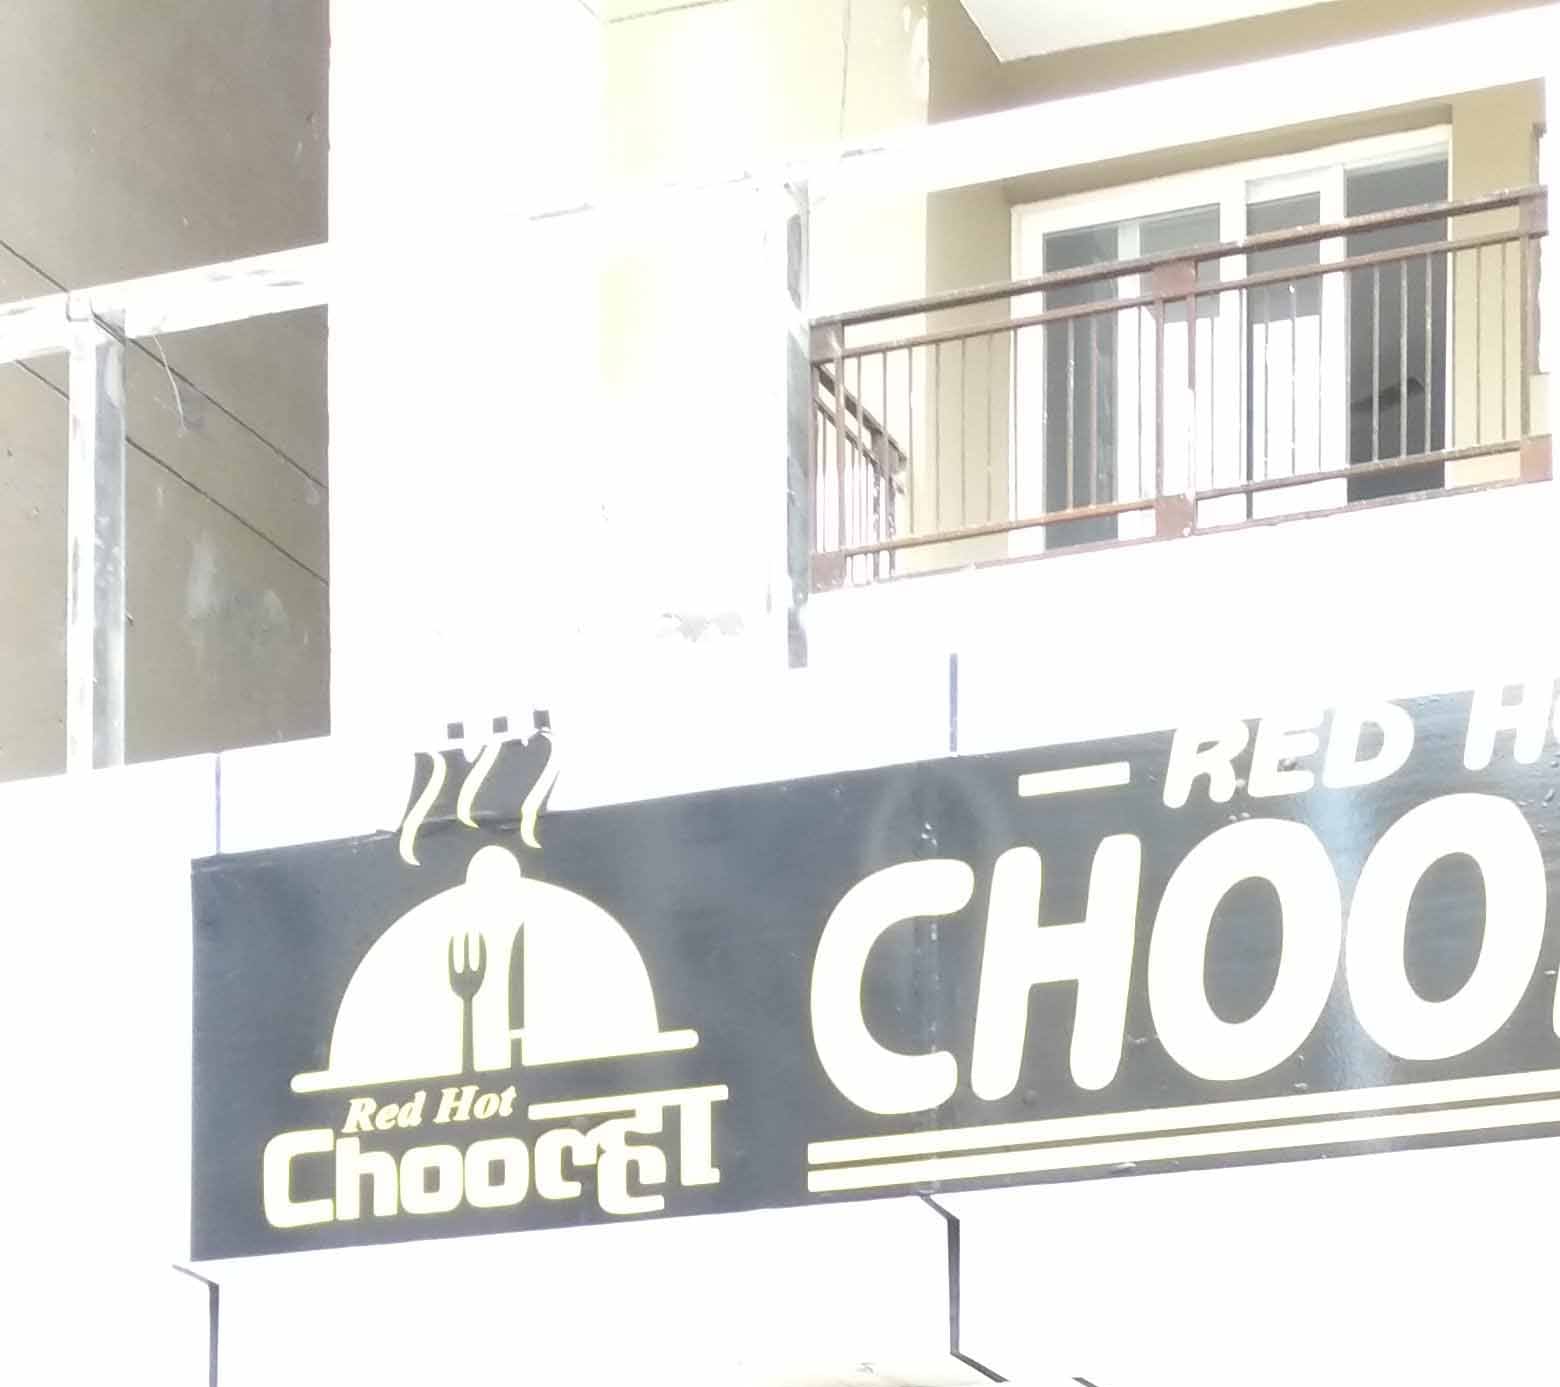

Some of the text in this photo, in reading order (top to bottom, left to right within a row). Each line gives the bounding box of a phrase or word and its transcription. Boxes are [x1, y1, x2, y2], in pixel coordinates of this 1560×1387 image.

[1163, 699, 1416, 808] RED
[341, 1084, 517, 1134] Red Hot
